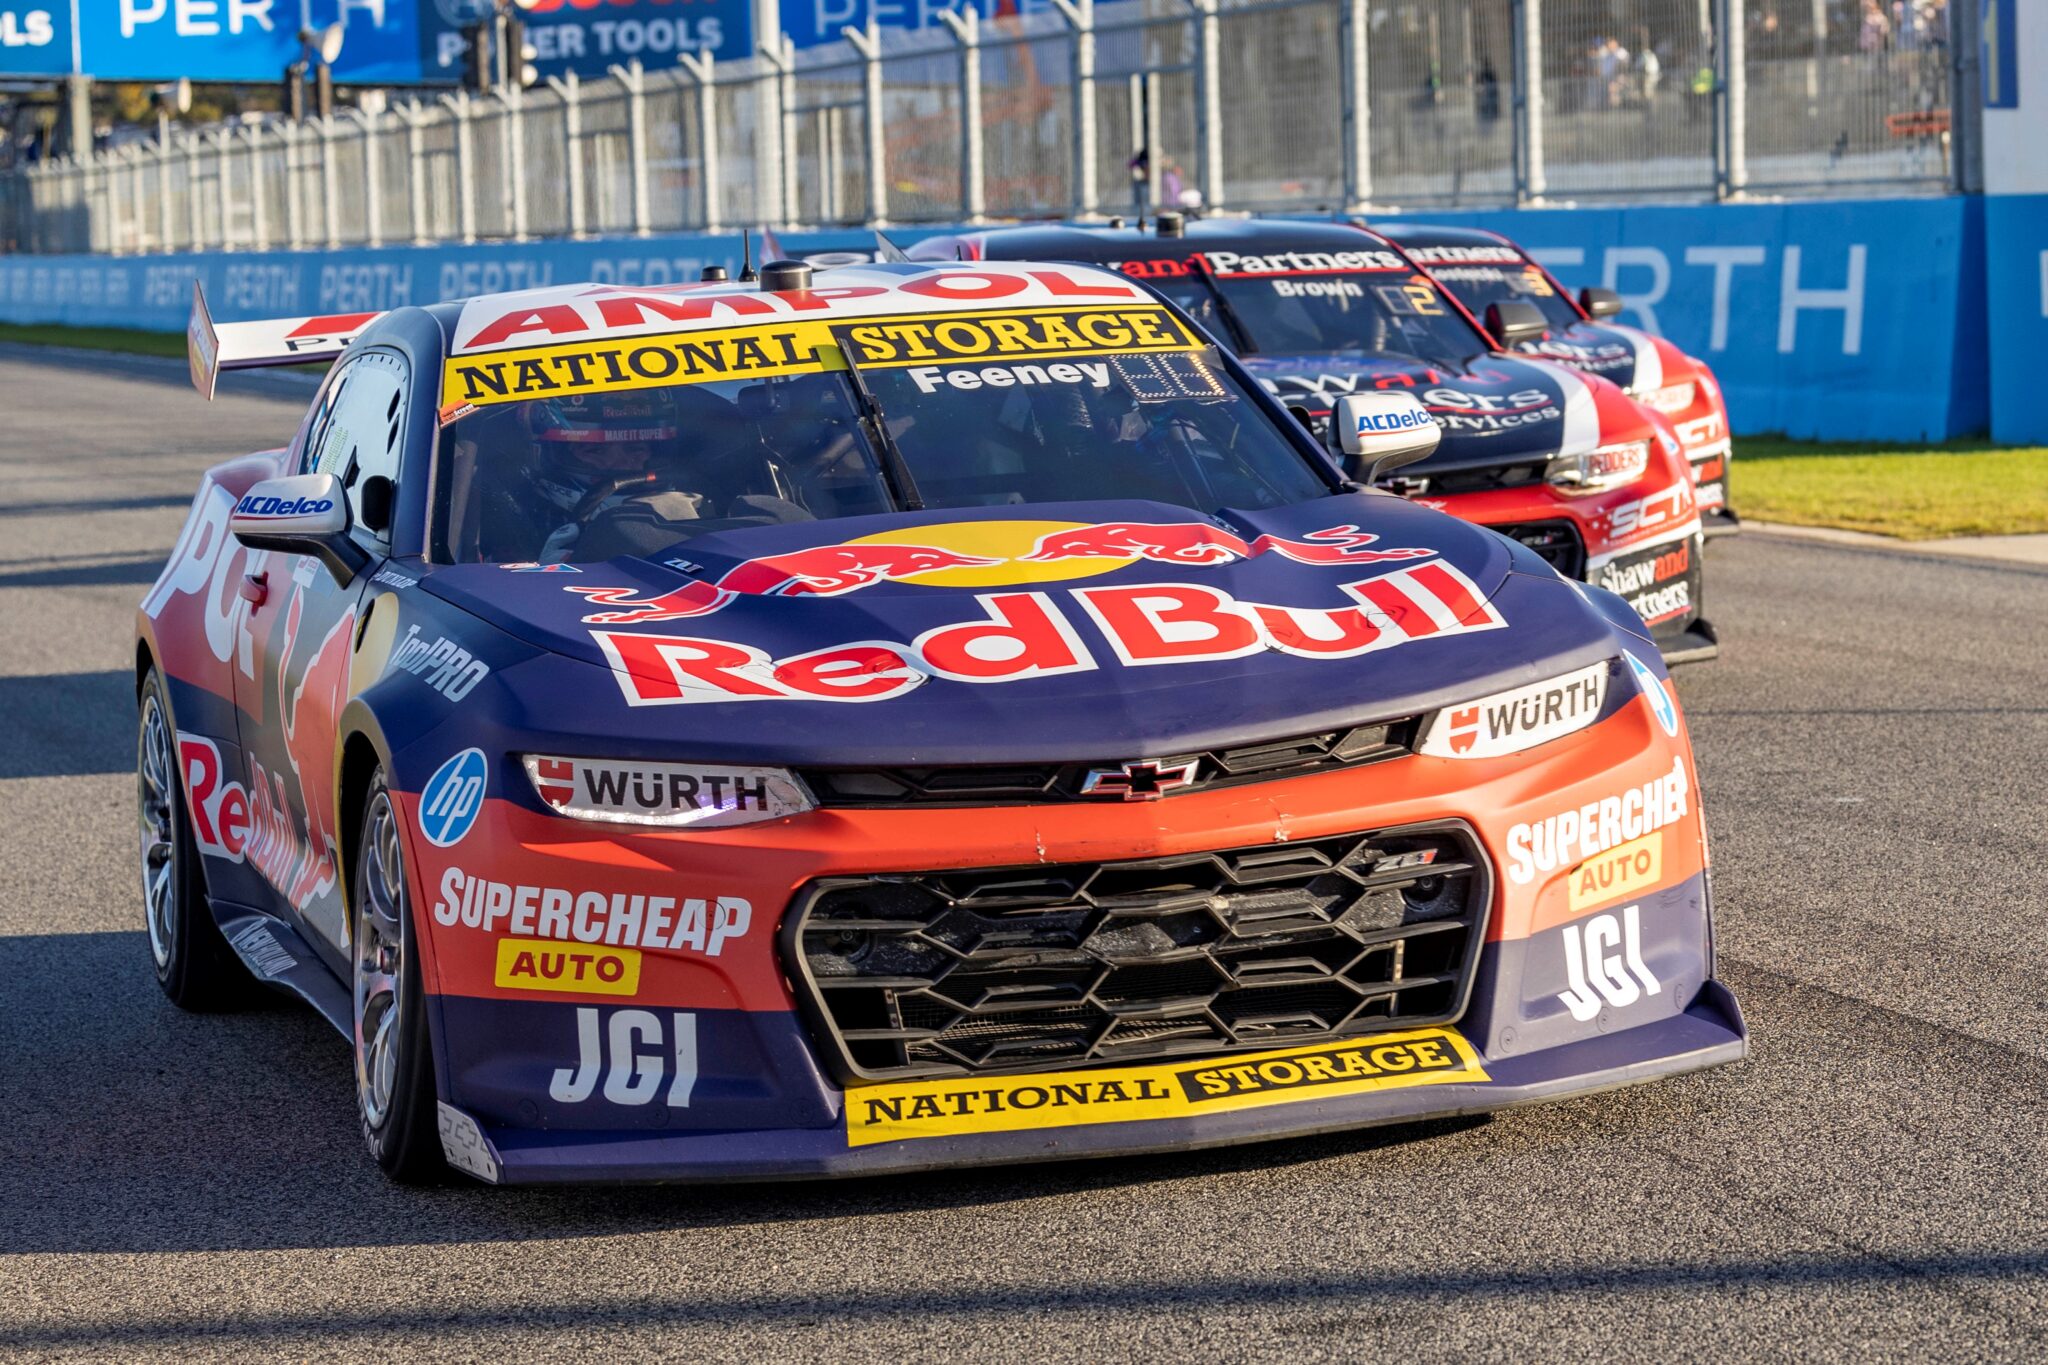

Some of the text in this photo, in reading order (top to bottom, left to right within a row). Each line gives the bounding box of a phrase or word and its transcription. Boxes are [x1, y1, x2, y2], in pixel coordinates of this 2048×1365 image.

[592, 17, 723, 54] TOOLS
[462, 271, 1137, 349] AMPOL
[1272, 279, 1363, 297] Brown
[456, 313, 1177, 399] NATIONAL STORAGE
[907, 361, 1111, 394] Feeney
[1357, 409, 1434, 432] ACDelco
[236, 495, 334, 515] ACDelco
[588, 558, 1509, 707] Red Bull
[1487, 675, 1598, 740] WÜRTH
[584, 767, 768, 811] WÜRTH
[1579, 848, 1651, 896] AUTO
[434, 866, 753, 957] SUPERCHEAP
[509, 951, 625, 983] AUTO
[1557, 904, 1662, 1022] JGI
[549, 1007, 698, 1108] JGI
[864, 1041, 1450, 1126] NATIONAL STORAGE
